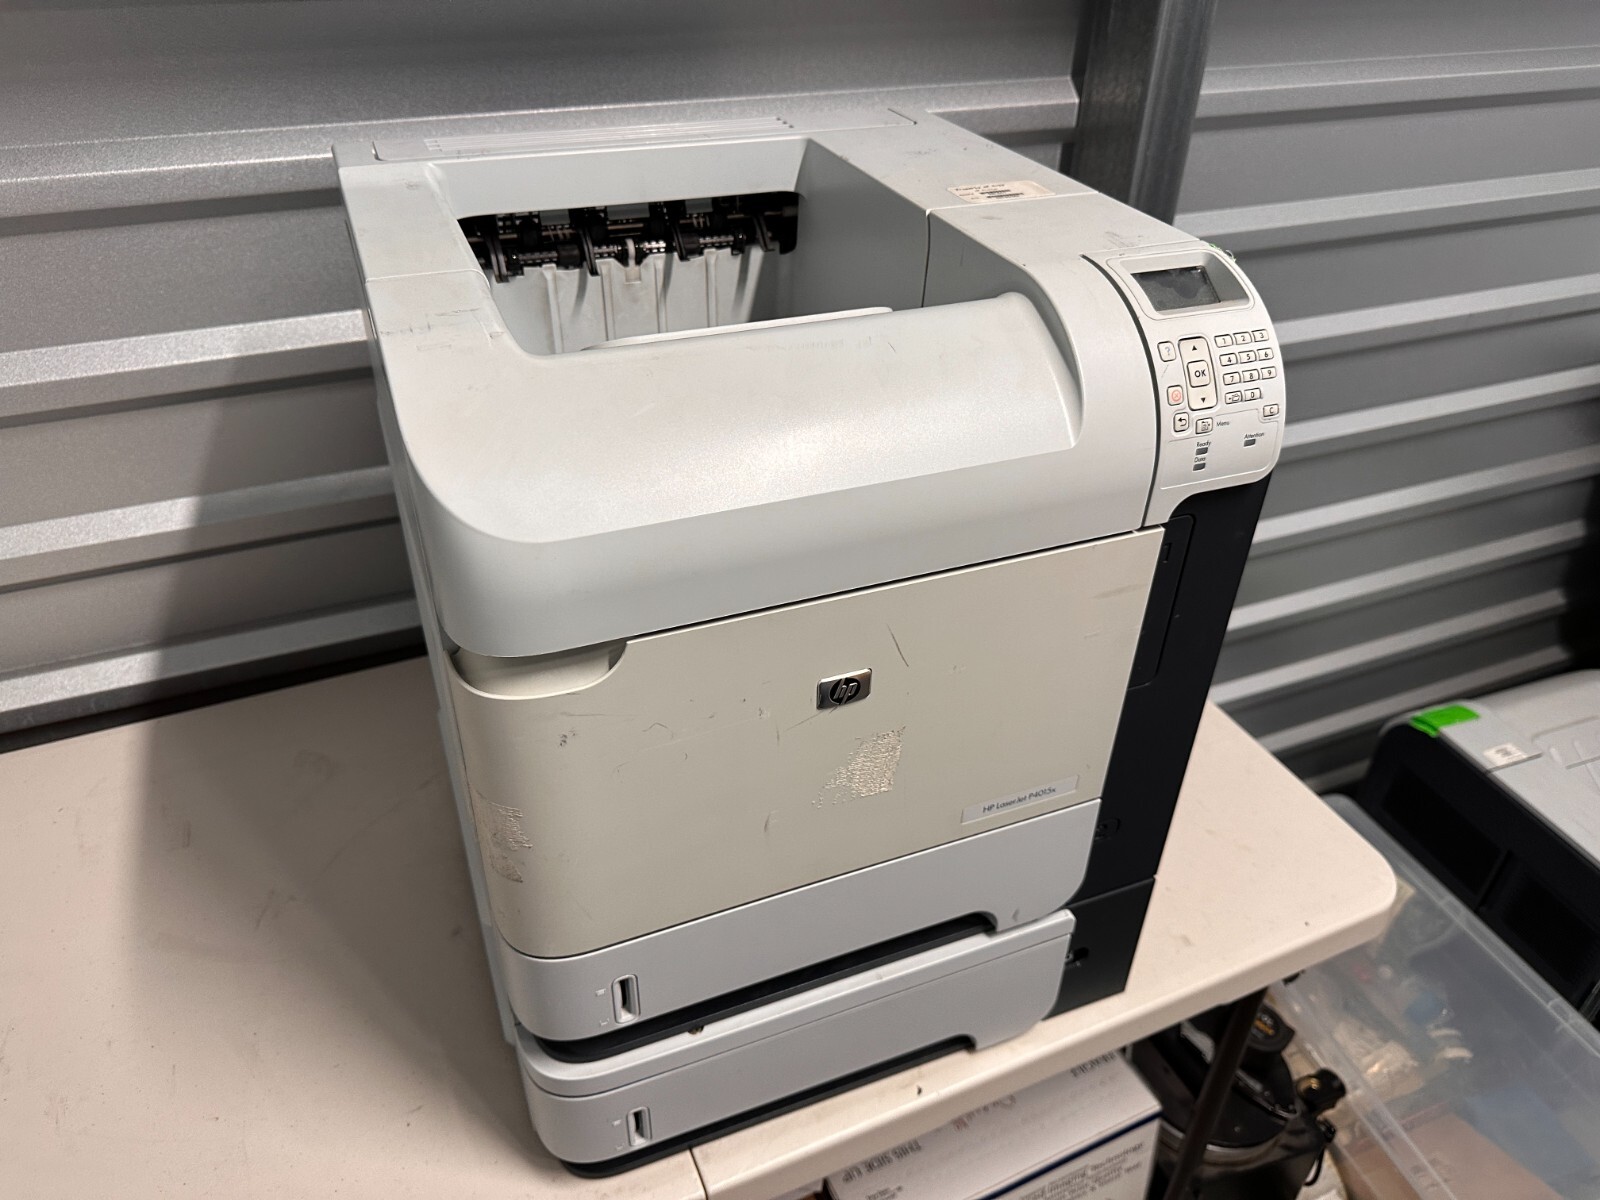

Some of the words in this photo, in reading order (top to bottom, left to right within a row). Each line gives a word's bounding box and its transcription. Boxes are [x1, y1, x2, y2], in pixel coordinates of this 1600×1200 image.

[1194, 369, 1207, 378] OK
[833, 678, 858, 704] hp
[982, 804, 995, 813] HP
[996, 795, 1027, 809] LaserJet
[1028, 787, 1057, 800] P4015x
